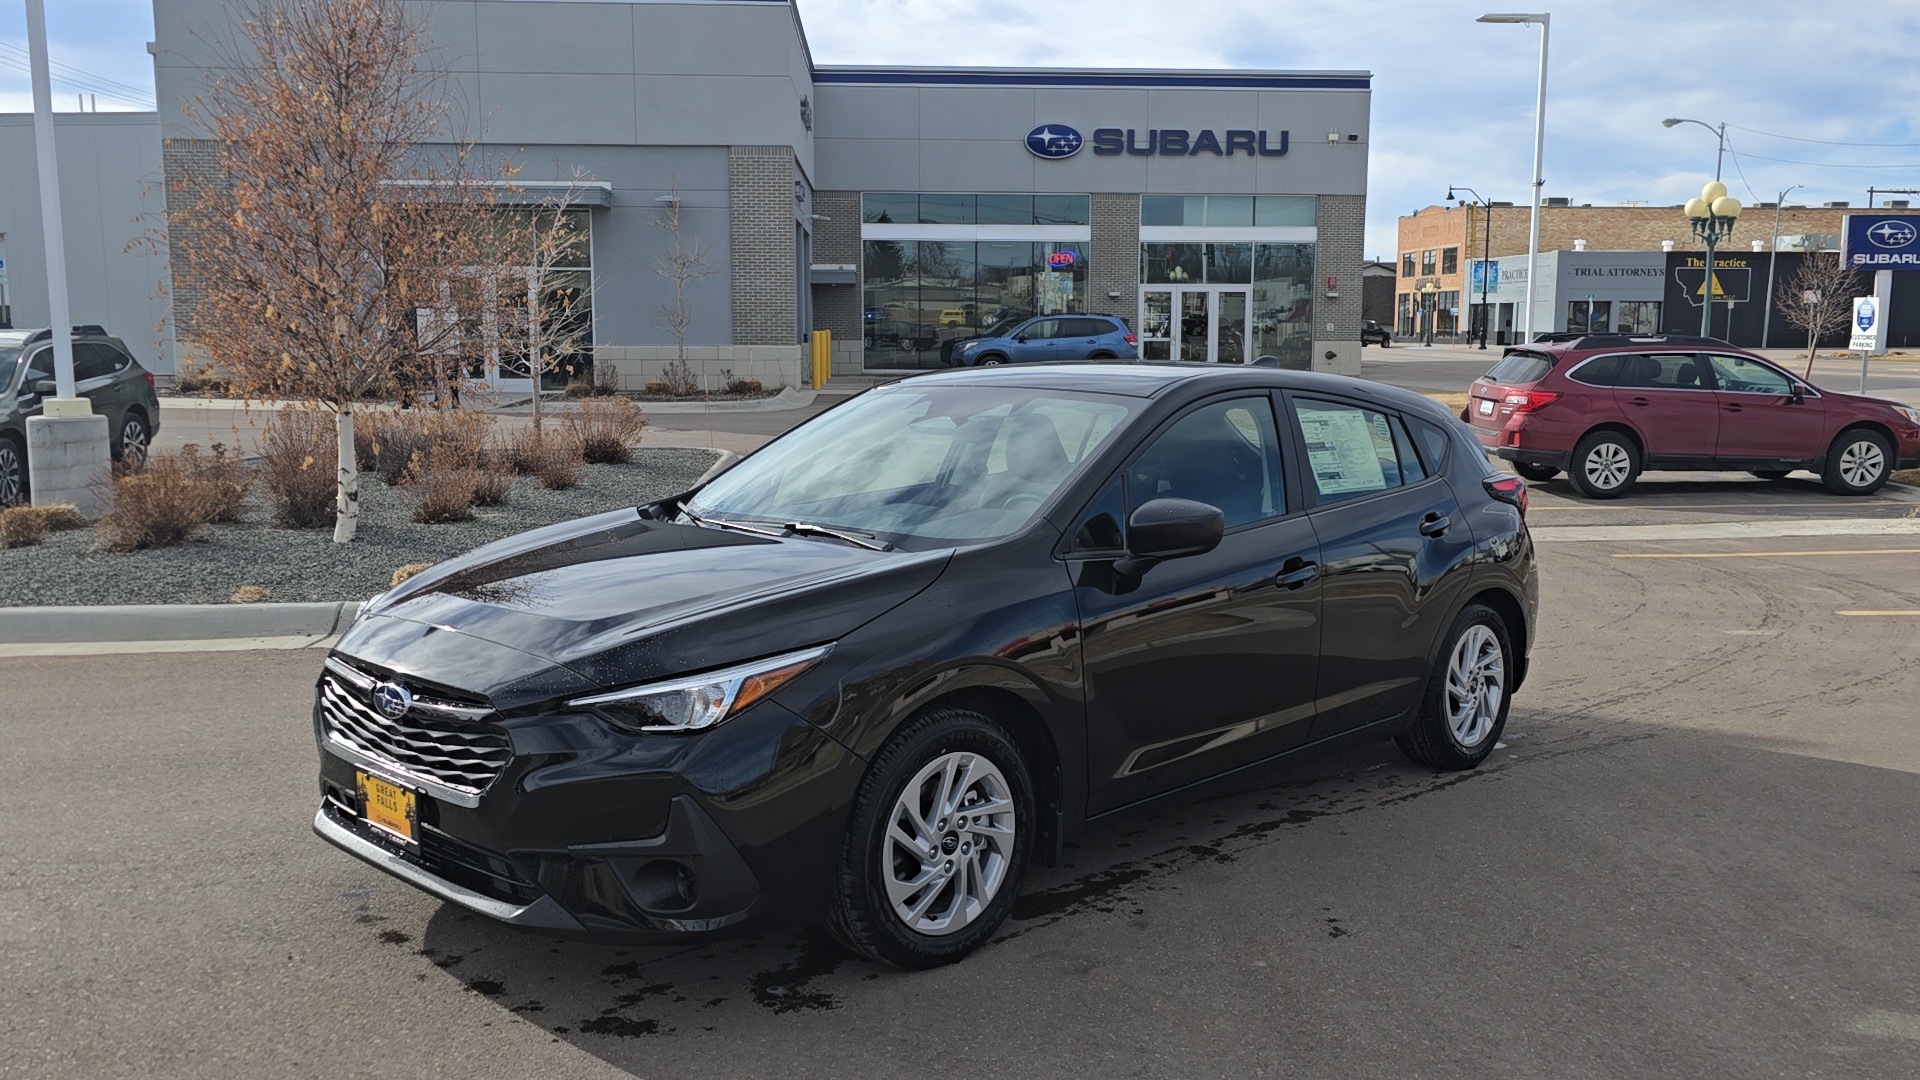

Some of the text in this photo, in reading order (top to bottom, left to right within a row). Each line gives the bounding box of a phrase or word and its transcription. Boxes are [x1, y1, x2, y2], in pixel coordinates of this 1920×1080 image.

[1093, 128, 1289, 156] SUBARU
[1049, 253, 1073, 264] OPEN
[1686, 257, 1747, 267] The ractice
[1574, 268, 1665, 277] TRIAL ATTORNEYS
[376, 783, 397, 800] GREAT
[376, 795, 398, 813] FALLS
